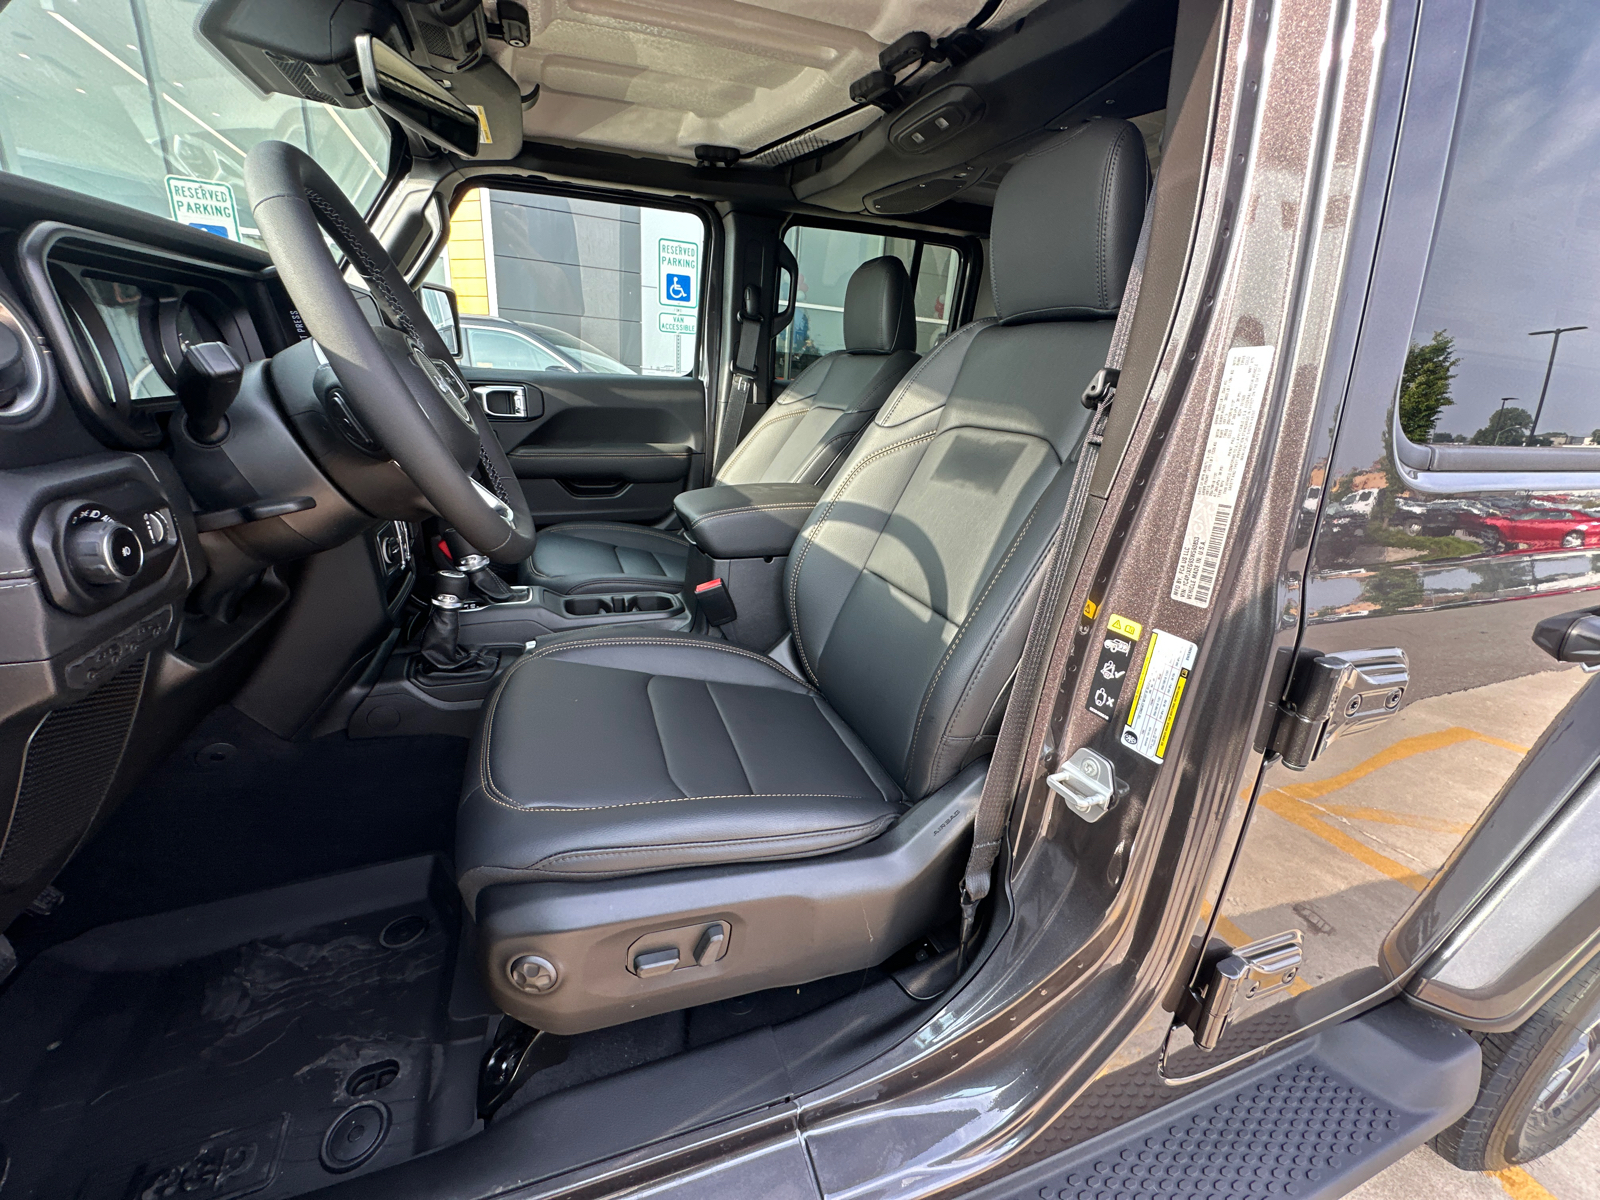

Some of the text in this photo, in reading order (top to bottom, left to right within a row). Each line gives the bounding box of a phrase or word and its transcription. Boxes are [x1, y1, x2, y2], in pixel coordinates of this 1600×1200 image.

[174, 185, 227, 203] RESERVED
[177, 201, 231, 218] PARKING
[662, 244, 695, 257] RESERVED
[662, 256, 695, 268] PARKING
[290, 310, 305, 332] PRESS
[662, 323, 695, 332] ACCESSIBLE
[1187, 580, 1196, 599] VEHICLE
[1192, 565, 1200, 579] MADE
[933, 809, 960, 836] AIRBAG
